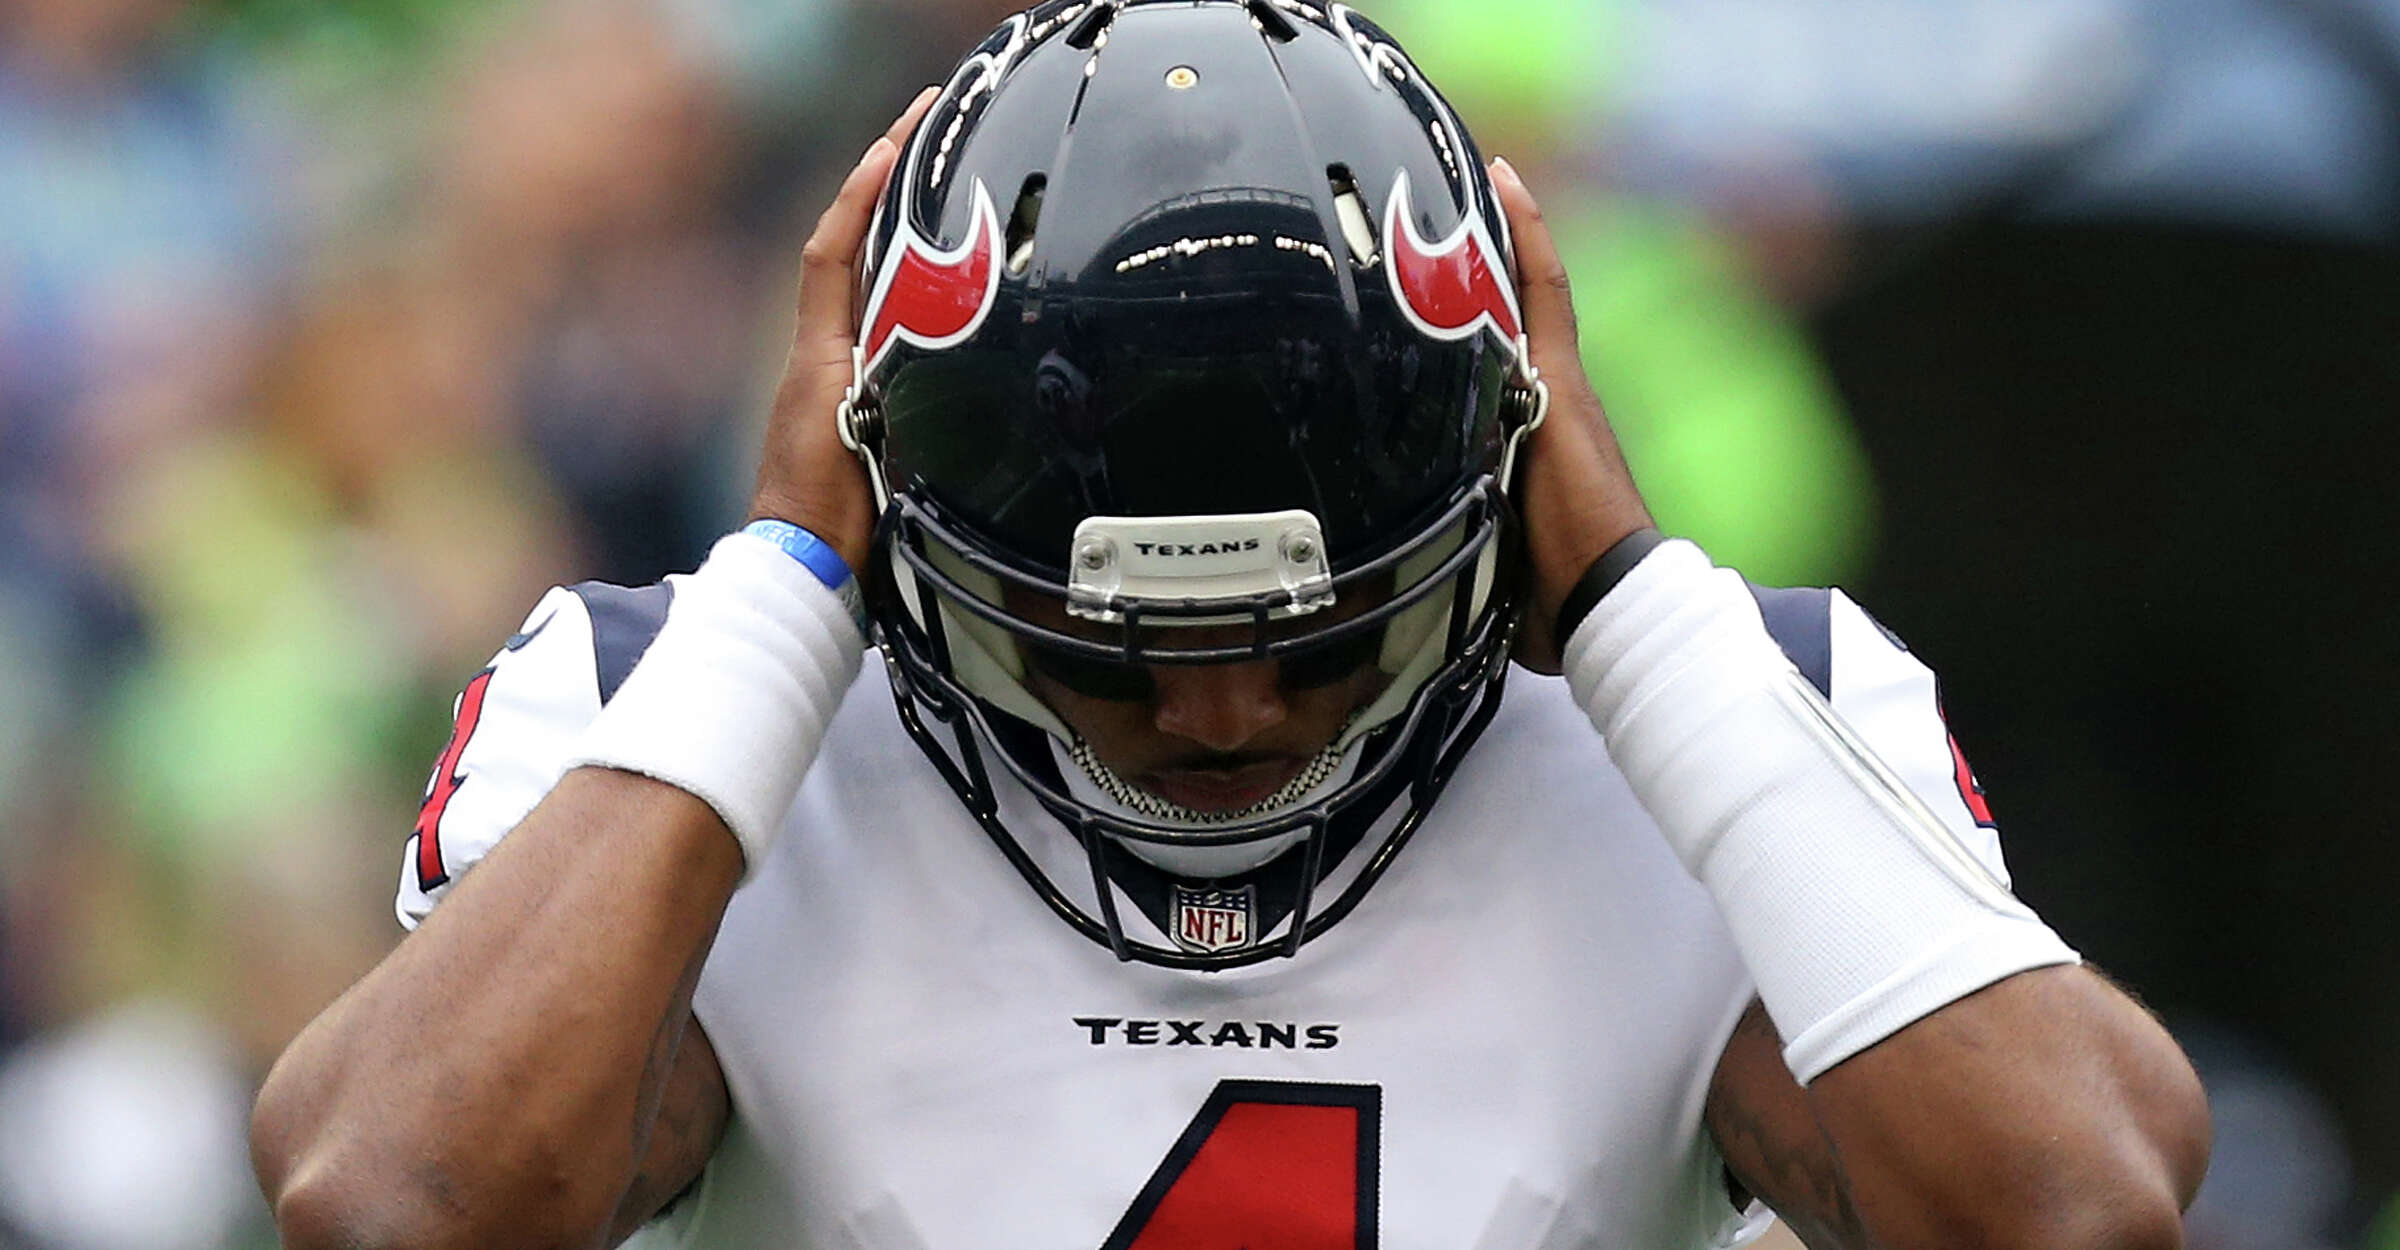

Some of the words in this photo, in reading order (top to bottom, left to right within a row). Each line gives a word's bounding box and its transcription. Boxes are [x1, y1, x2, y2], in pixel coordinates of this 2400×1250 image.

[1134, 538, 1260, 556] TEXANS
[1183, 907, 1242, 947] NFL
[1073, 1018, 1341, 1049] TEXANS
